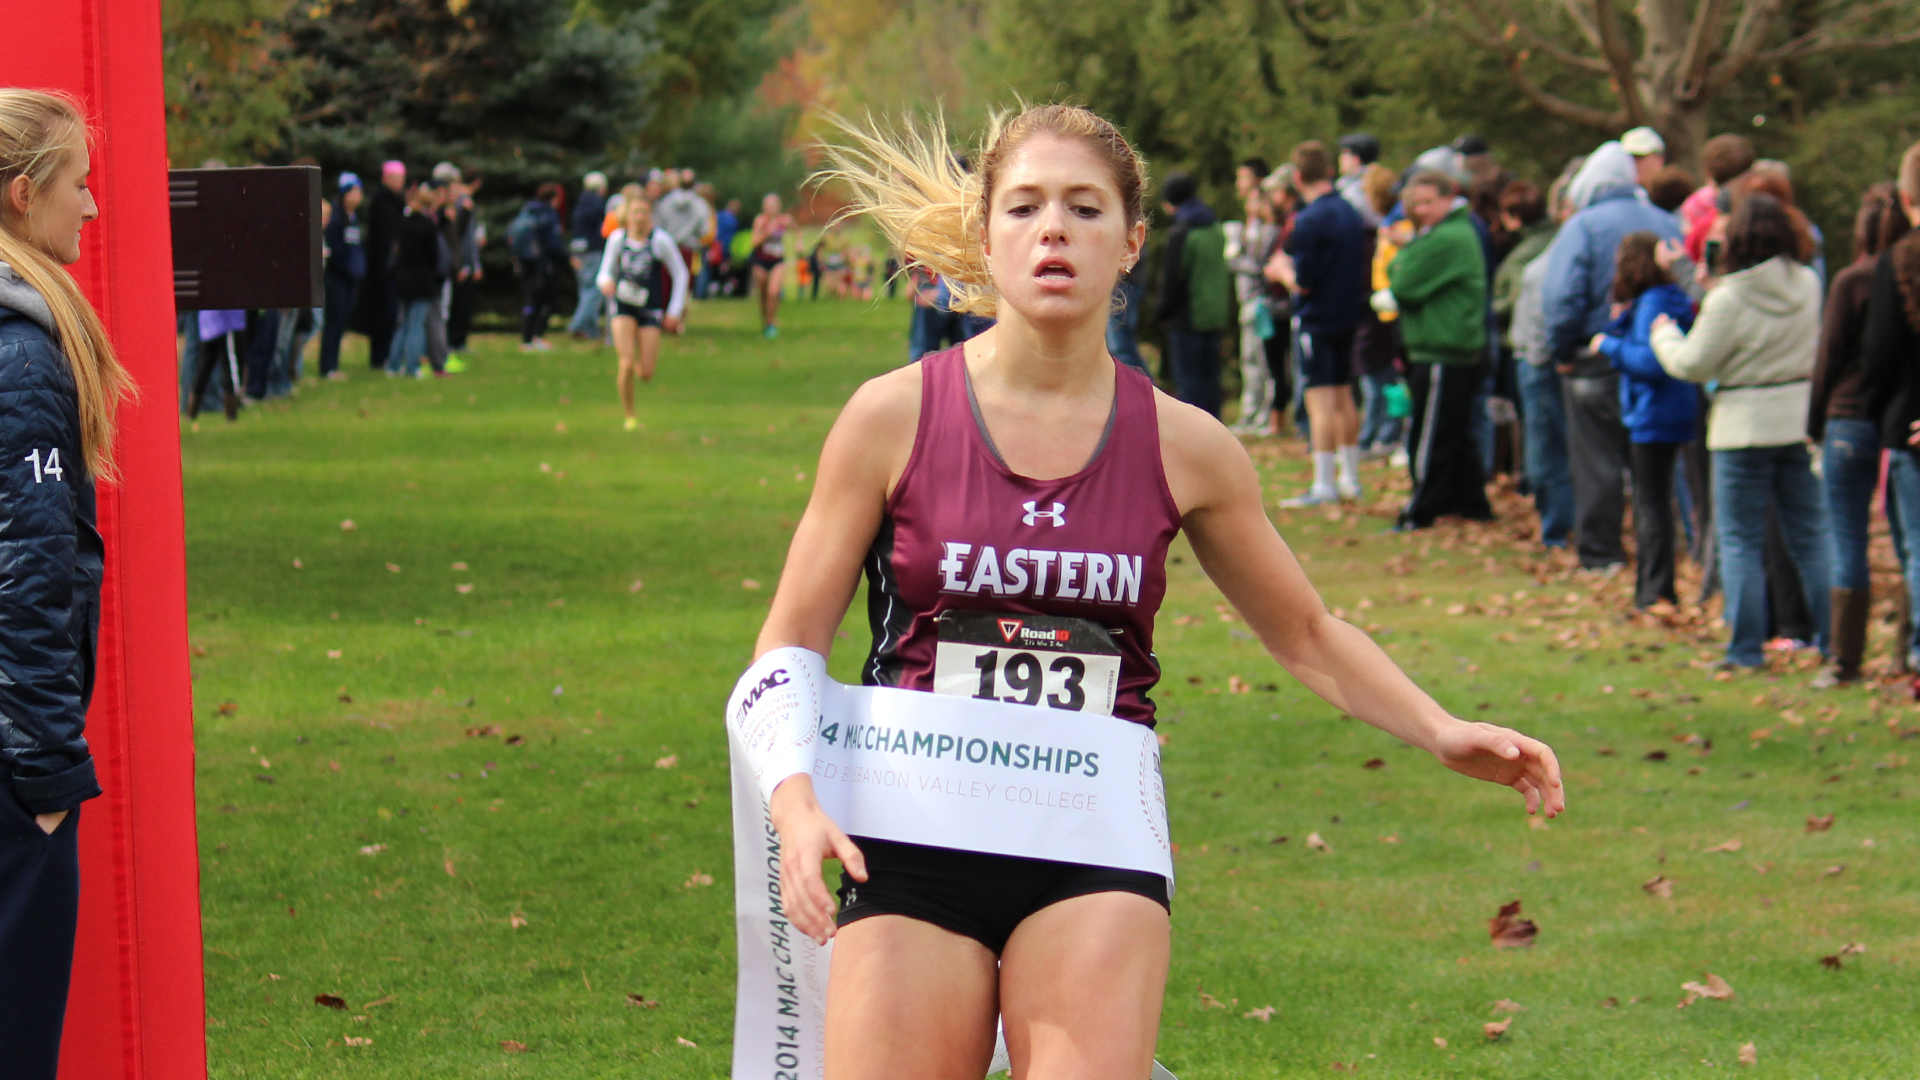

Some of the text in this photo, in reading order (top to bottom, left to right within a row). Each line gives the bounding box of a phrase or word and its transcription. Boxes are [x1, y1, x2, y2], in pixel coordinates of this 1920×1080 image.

[24, 447, 63, 484] 14
[938, 541, 1143, 607] EASTERN
[741, 667, 791, 717] MAC
[971, 650, 1086, 712] 193
[843, 724, 864, 750] MAC
[864, 725, 1100, 778] CHAMPIONSHIPS
[918, 775, 997, 799] VALLEY
[1004, 785, 1098, 812] COLLEGE
[775, 966, 799, 1018] MAC
